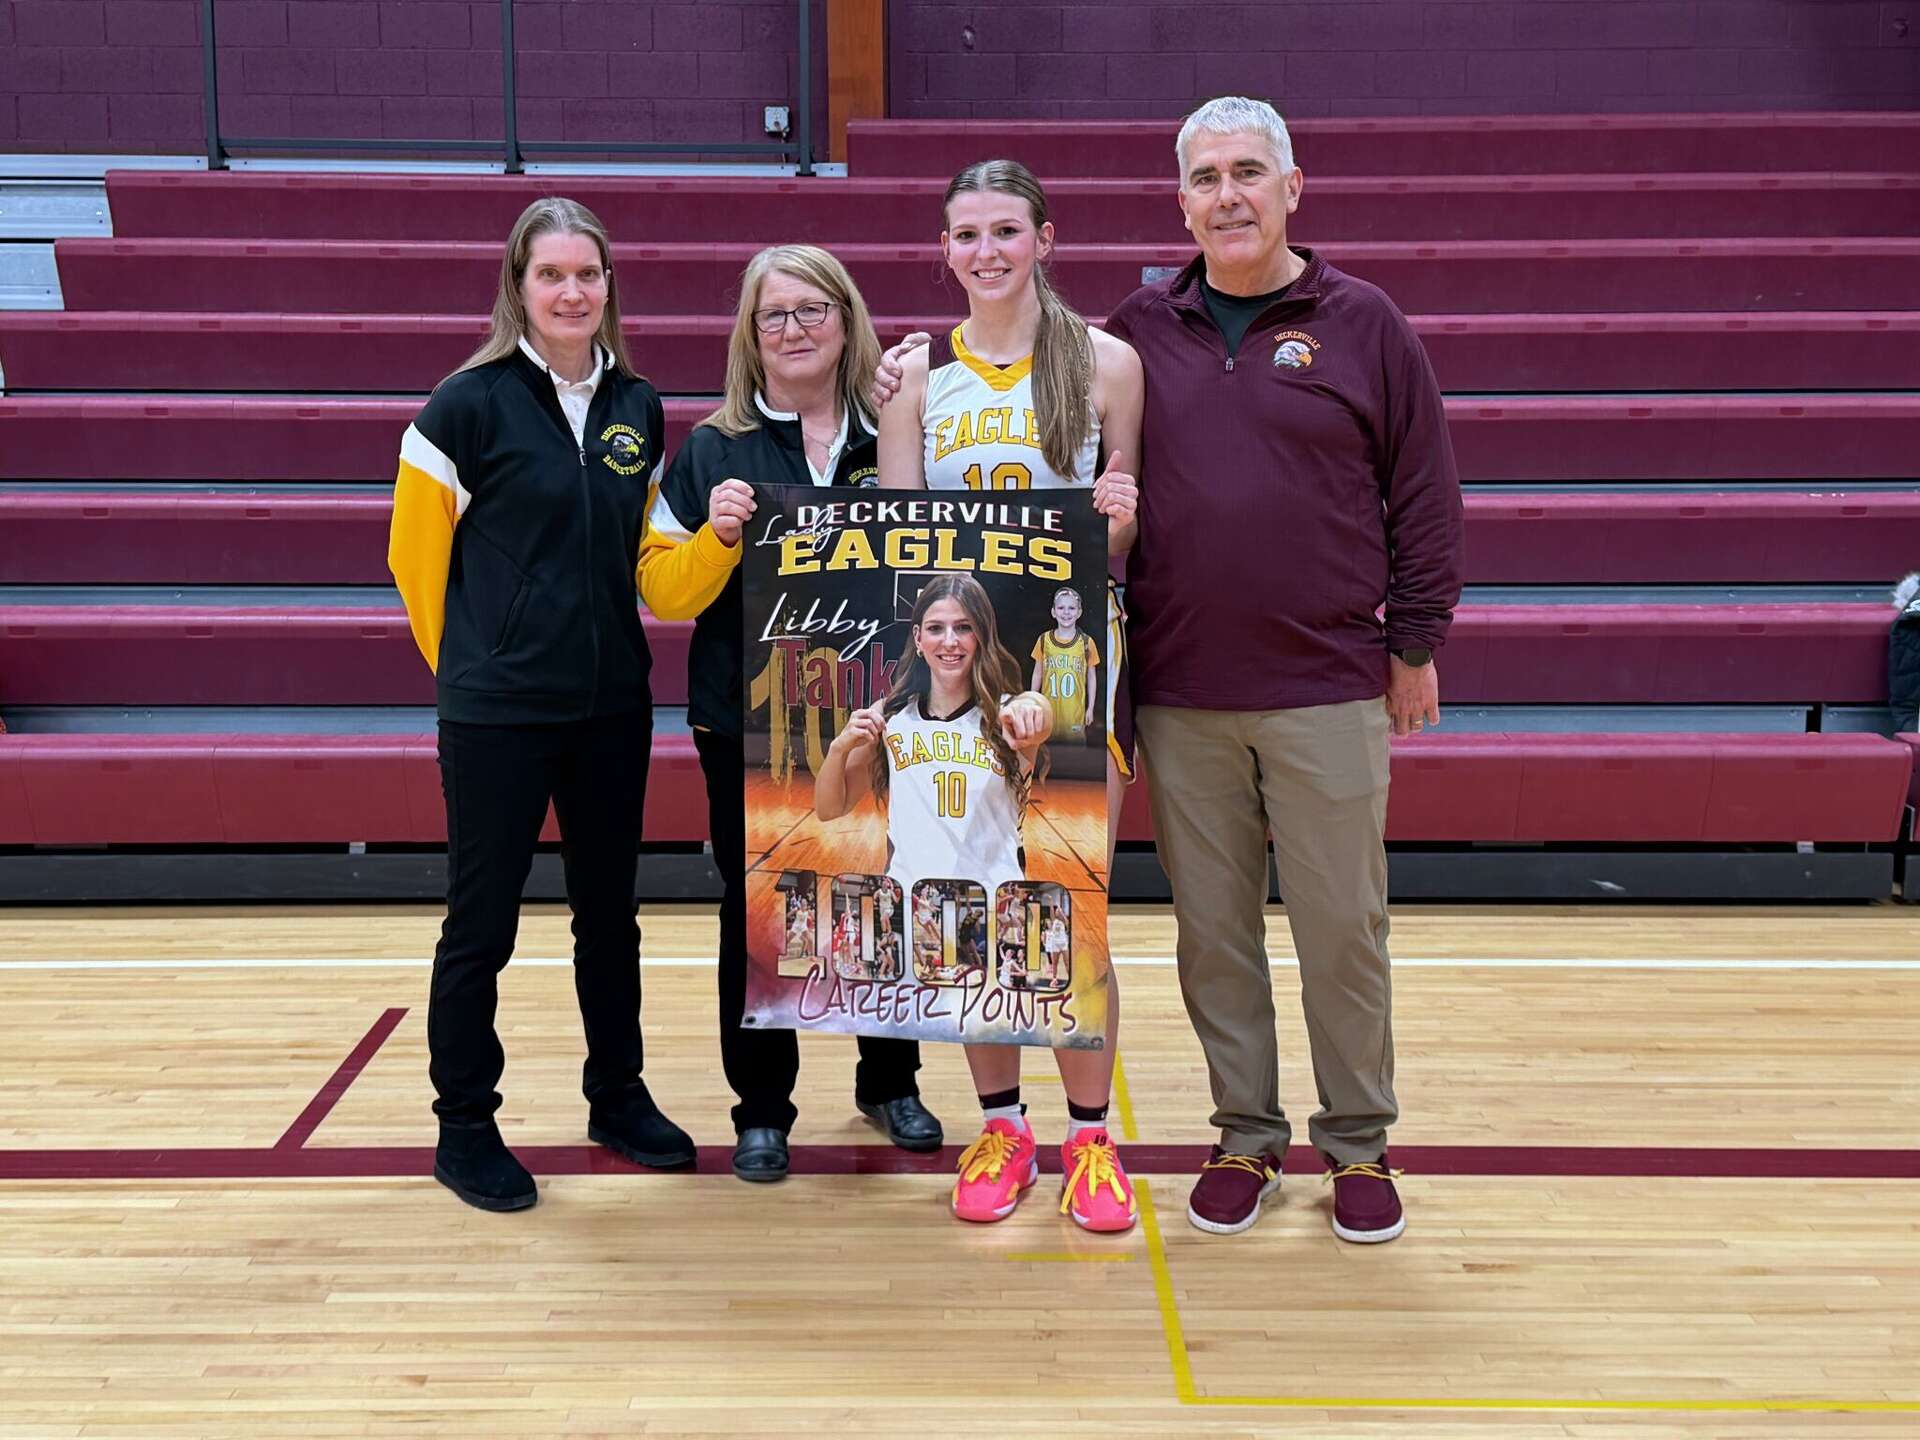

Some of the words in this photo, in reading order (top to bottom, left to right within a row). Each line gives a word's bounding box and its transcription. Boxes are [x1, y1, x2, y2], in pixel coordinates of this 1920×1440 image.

[1274, 331, 1321, 350] DECKERVILLE
[601, 424, 645, 445] DECKERVILLE
[935, 406, 1043, 462] EAGLE
[603, 454, 646, 475] BASKETBALL
[755, 507, 842, 552] Lady
[797, 500, 1064, 532] DECKERVILLE
[778, 528, 1072, 582] EAGLES
[758, 592, 887, 661] Libby
[1050, 672, 1076, 699] 10
[886, 731, 1007, 777] EAGLES
[933, 771, 967, 818] 10
[775, 868, 1072, 993] 1000
